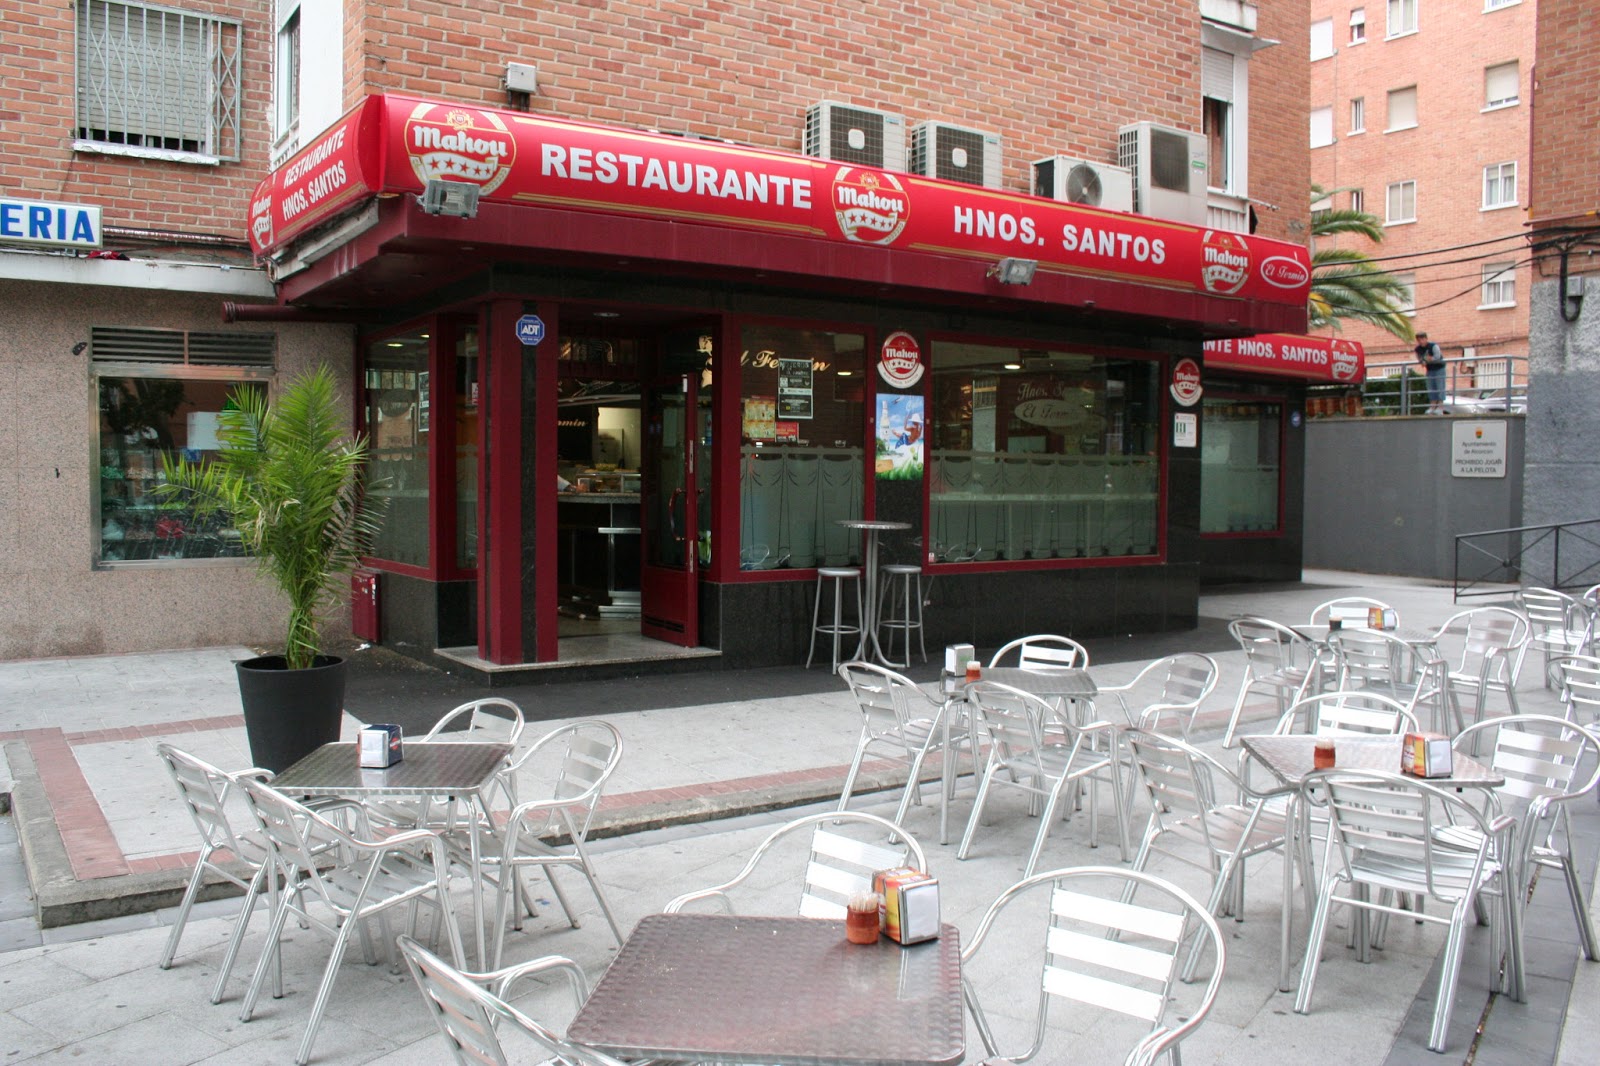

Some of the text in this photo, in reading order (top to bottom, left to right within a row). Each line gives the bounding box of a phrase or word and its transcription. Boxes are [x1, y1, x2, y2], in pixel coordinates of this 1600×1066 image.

[413, 125, 508, 157] Mahou
[282, 124, 348, 189] RESTAURANTE
[282, 160, 347, 221] HNOS. SANTOS
[541, 143, 812, 209] RESTAURANTE
[837, 185, 905, 213] Mahou
[0, 203, 95, 243] ERIA
[954, 206, 1166, 265] HNOS. SANTOS
[1204, 246, 1249, 268] Mahou
[521, 324, 541, 336] ADT
[885, 348, 918, 359] Mahou
[1238, 339, 1277, 359] HNOS.
[1282, 345, 1328, 365] SANTOS
[1332, 350, 1358, 364] Mahou
